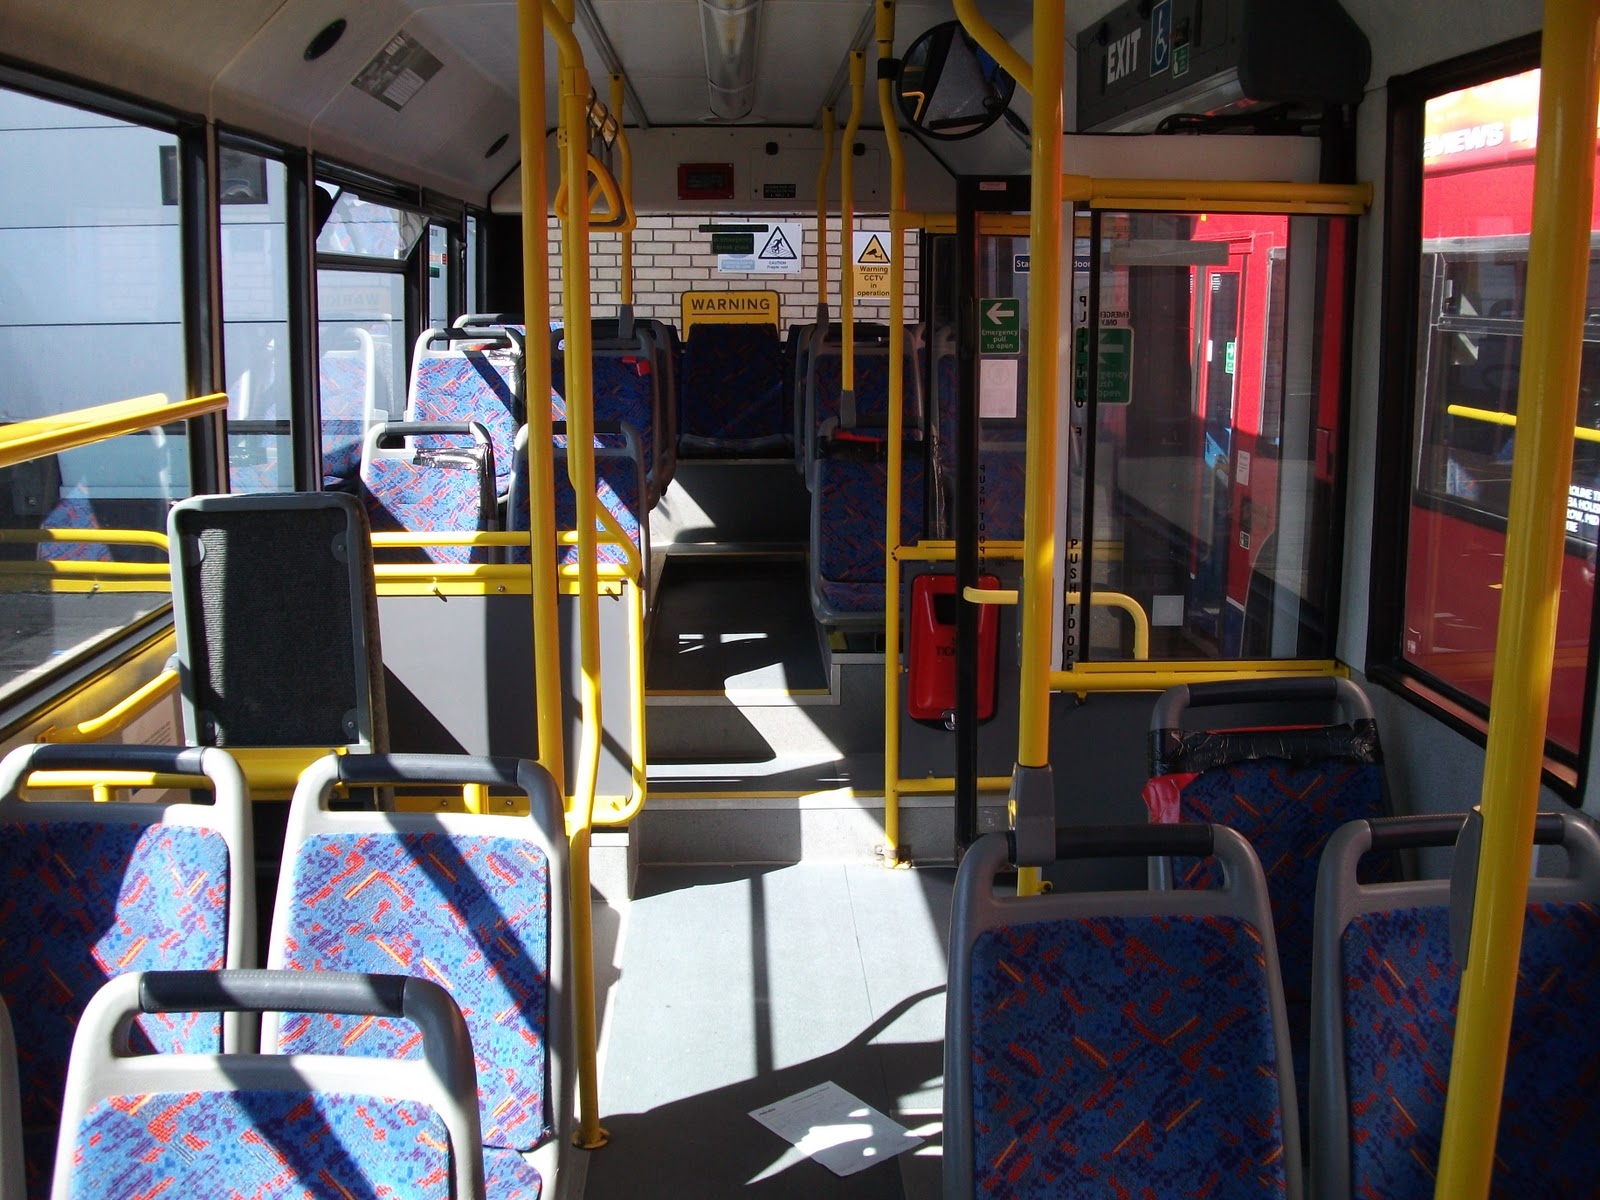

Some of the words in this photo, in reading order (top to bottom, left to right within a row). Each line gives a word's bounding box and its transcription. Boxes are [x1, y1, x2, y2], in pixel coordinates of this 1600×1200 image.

[1107, 27, 1142, 84] EXIT
[691, 298, 770, 310] WARNING
[981, 329, 1018, 337] Emergency
[1069, 539, 1078, 593] PUSH
